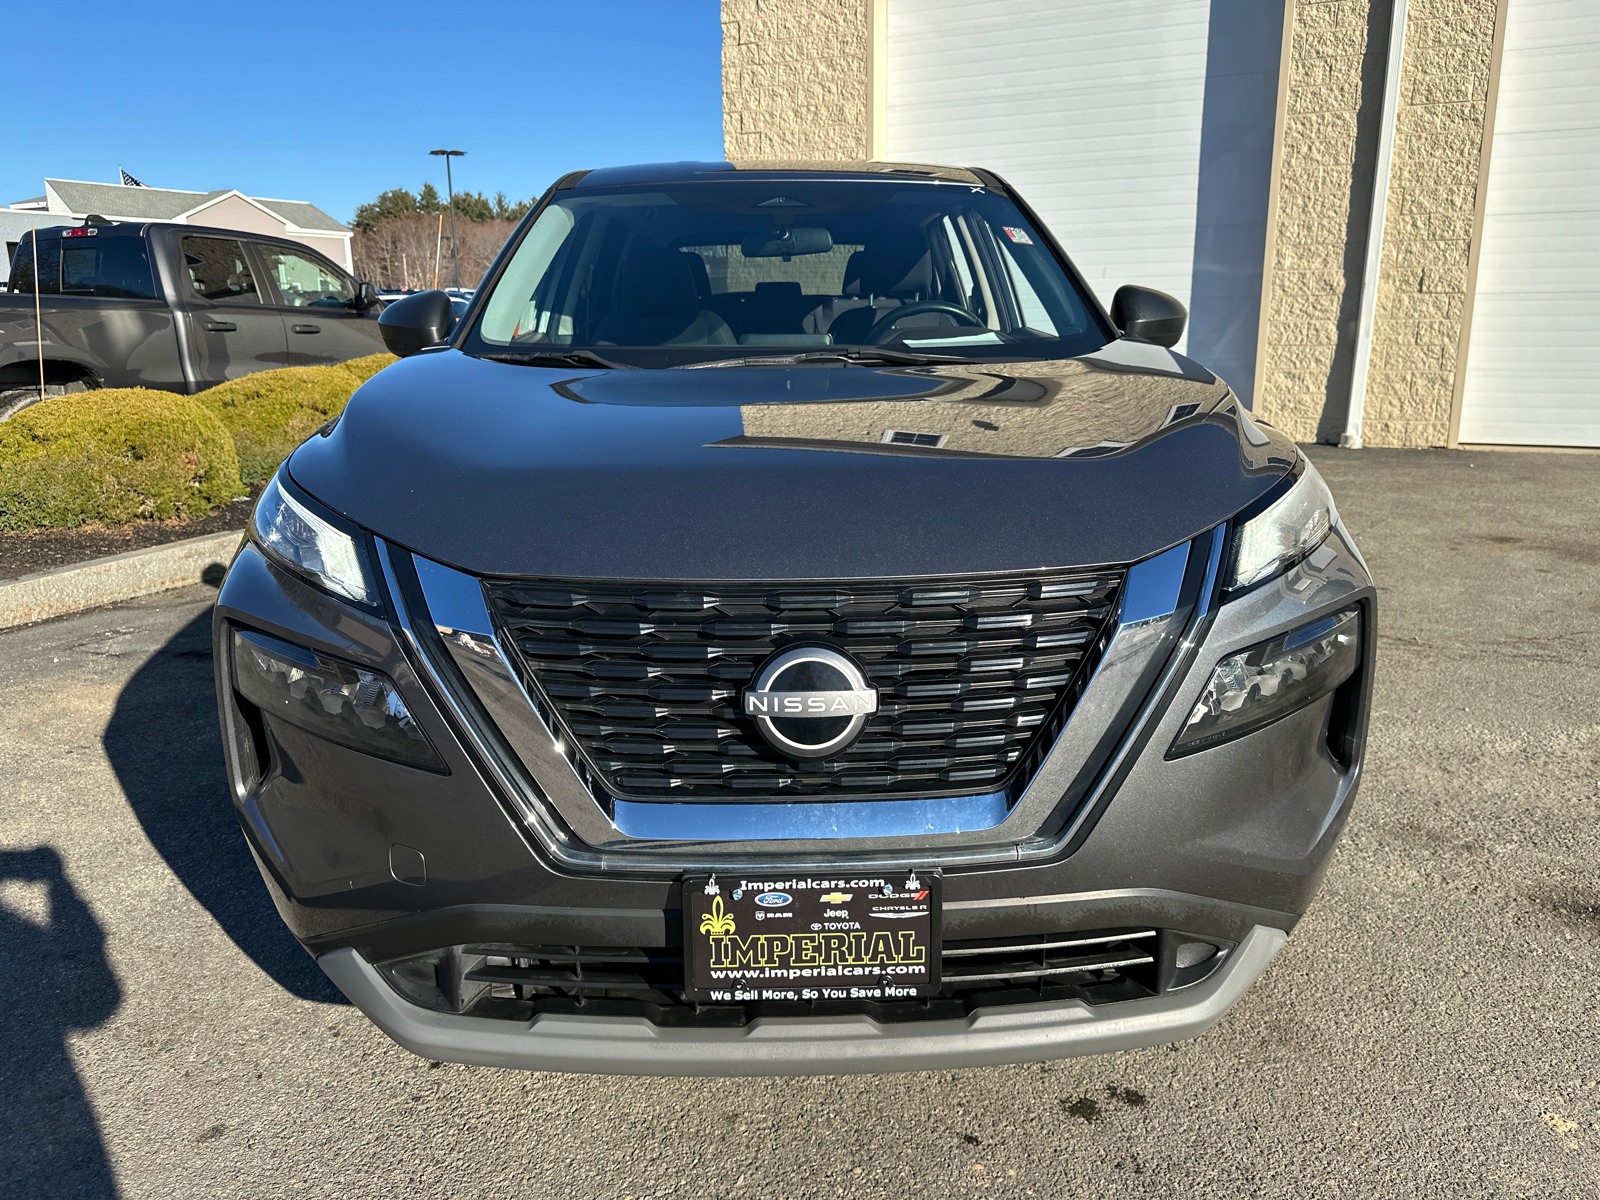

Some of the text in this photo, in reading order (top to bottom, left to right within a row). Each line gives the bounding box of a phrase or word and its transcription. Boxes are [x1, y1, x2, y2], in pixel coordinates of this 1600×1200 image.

[749, 693, 873, 713] NISSAN
[740, 878, 885, 892] Imperialcars.com
[762, 895, 784, 905] Ford
[823, 921, 861, 930] TOYOTA
[709, 931, 926, 968] IMPERIAL
[710, 965, 926, 980] www.imperialcars.com
[710, 986, 917, 1001] We Sell More, So You Save More
